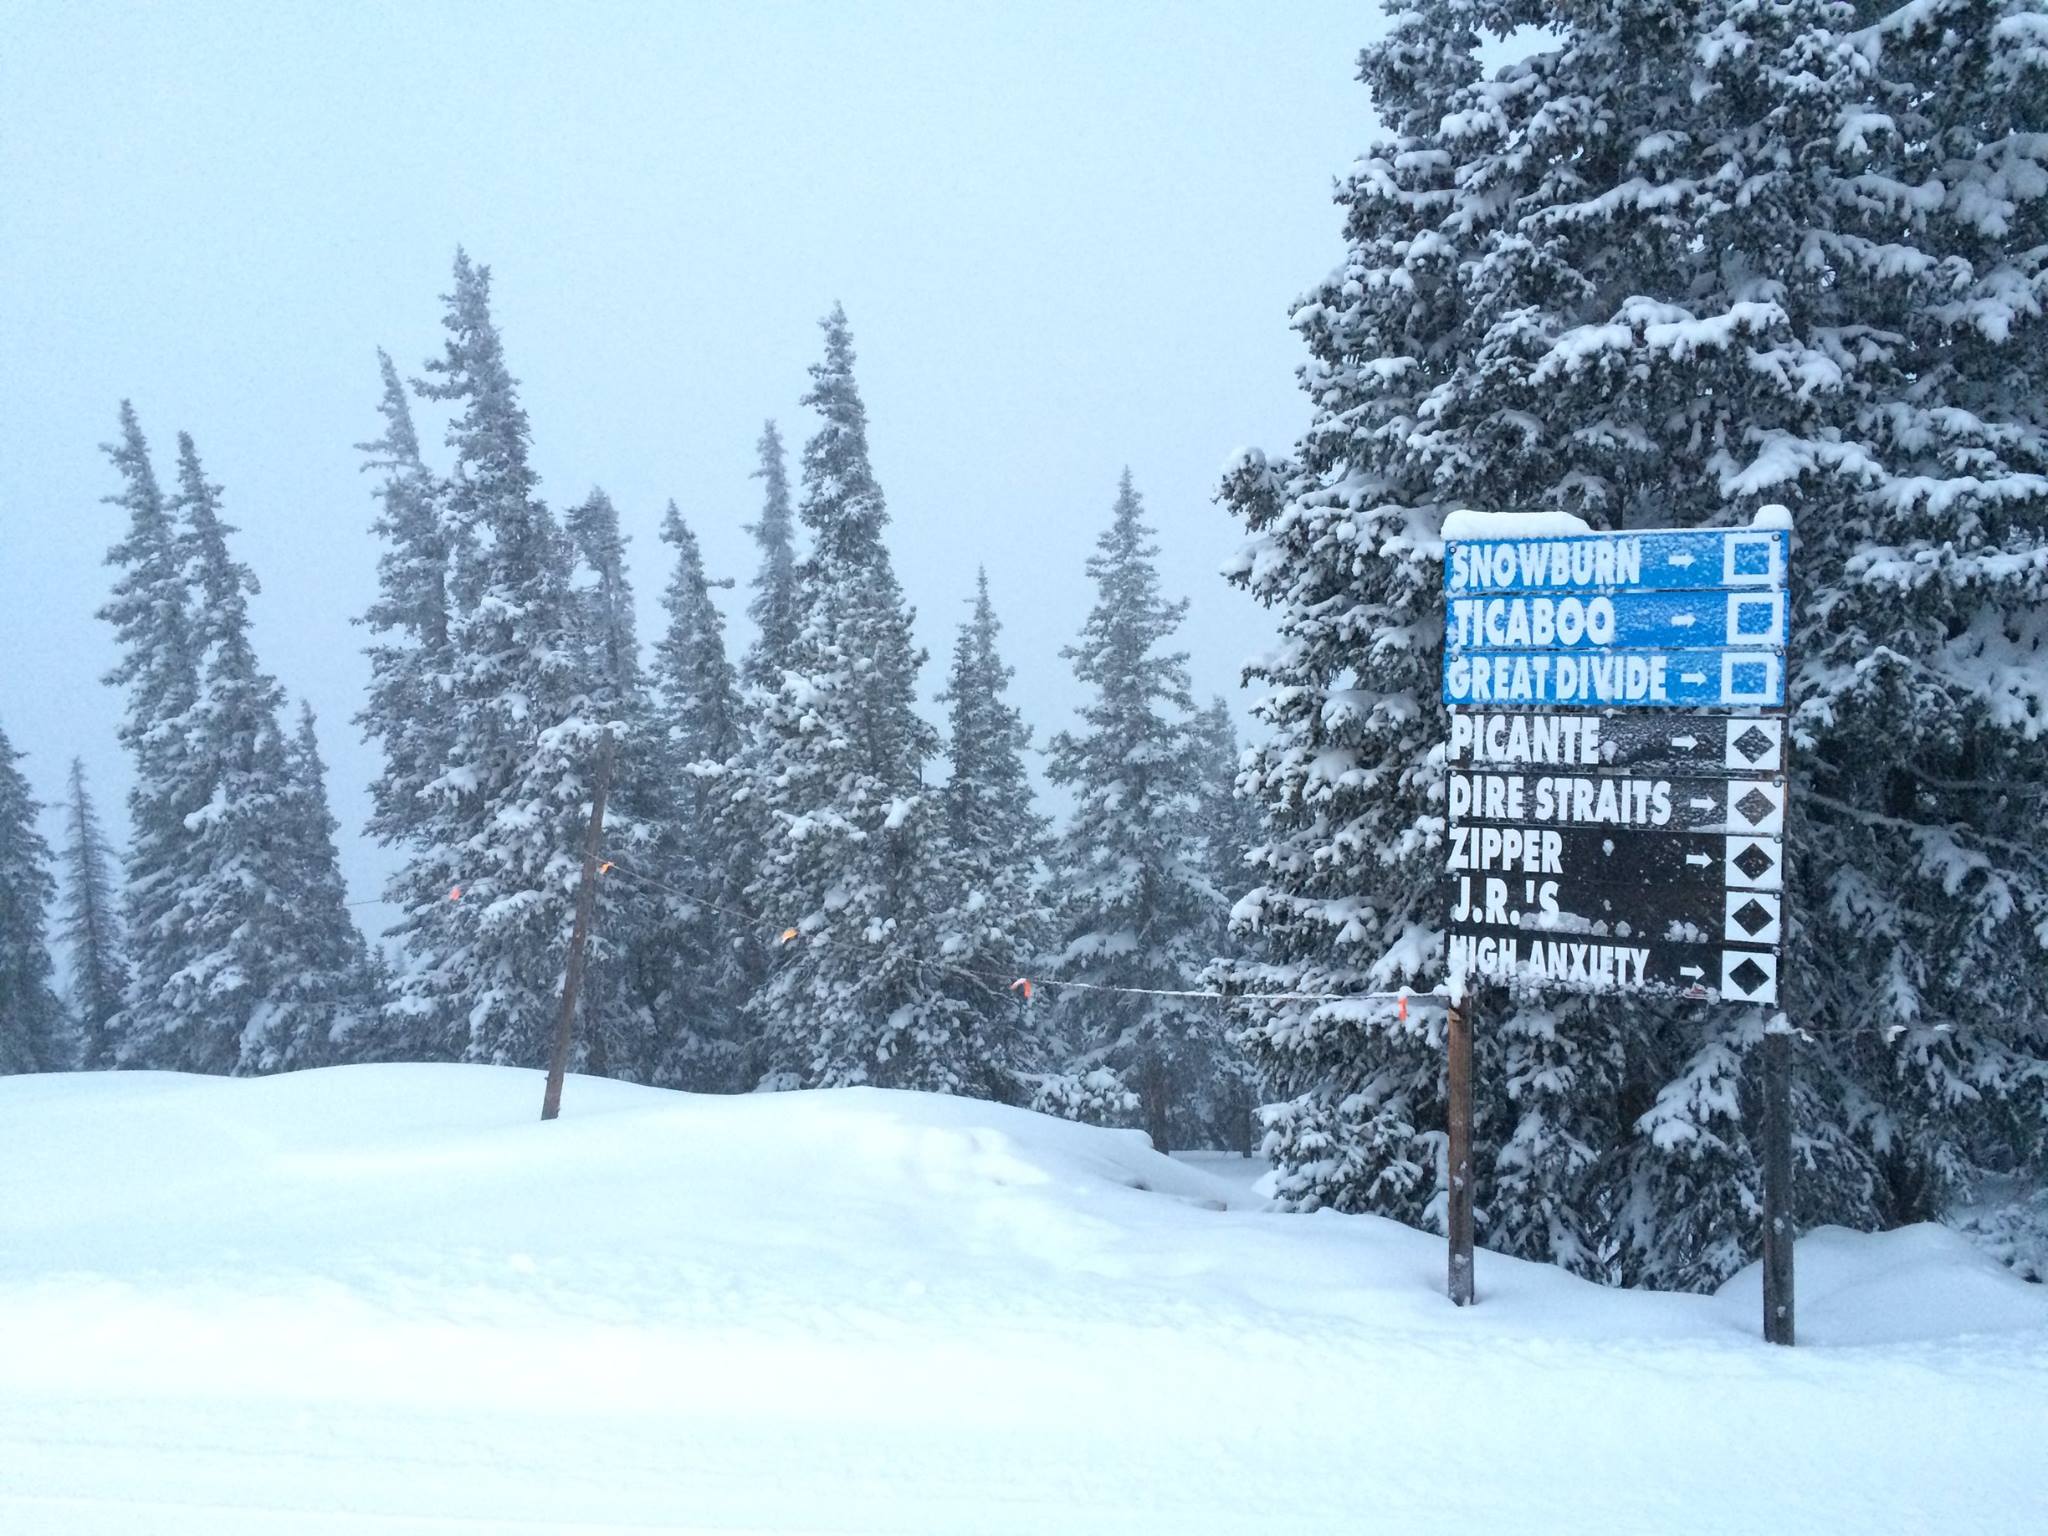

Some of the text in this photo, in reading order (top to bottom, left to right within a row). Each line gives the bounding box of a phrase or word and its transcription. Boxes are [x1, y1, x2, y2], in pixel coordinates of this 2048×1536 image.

[1450, 539, 1640, 588] SNOWBURN
[1454, 597, 1614, 646] TICABOO
[1448, 656, 1667, 700] GREAT DIVIDE
[1451, 715, 1600, 764] PICANTE
[1450, 775, 1671, 826] DIRE STRAITS
[1449, 827, 1563, 874] ZIPPER
[1450, 935, 1650, 987] HIGH ANXIETY
